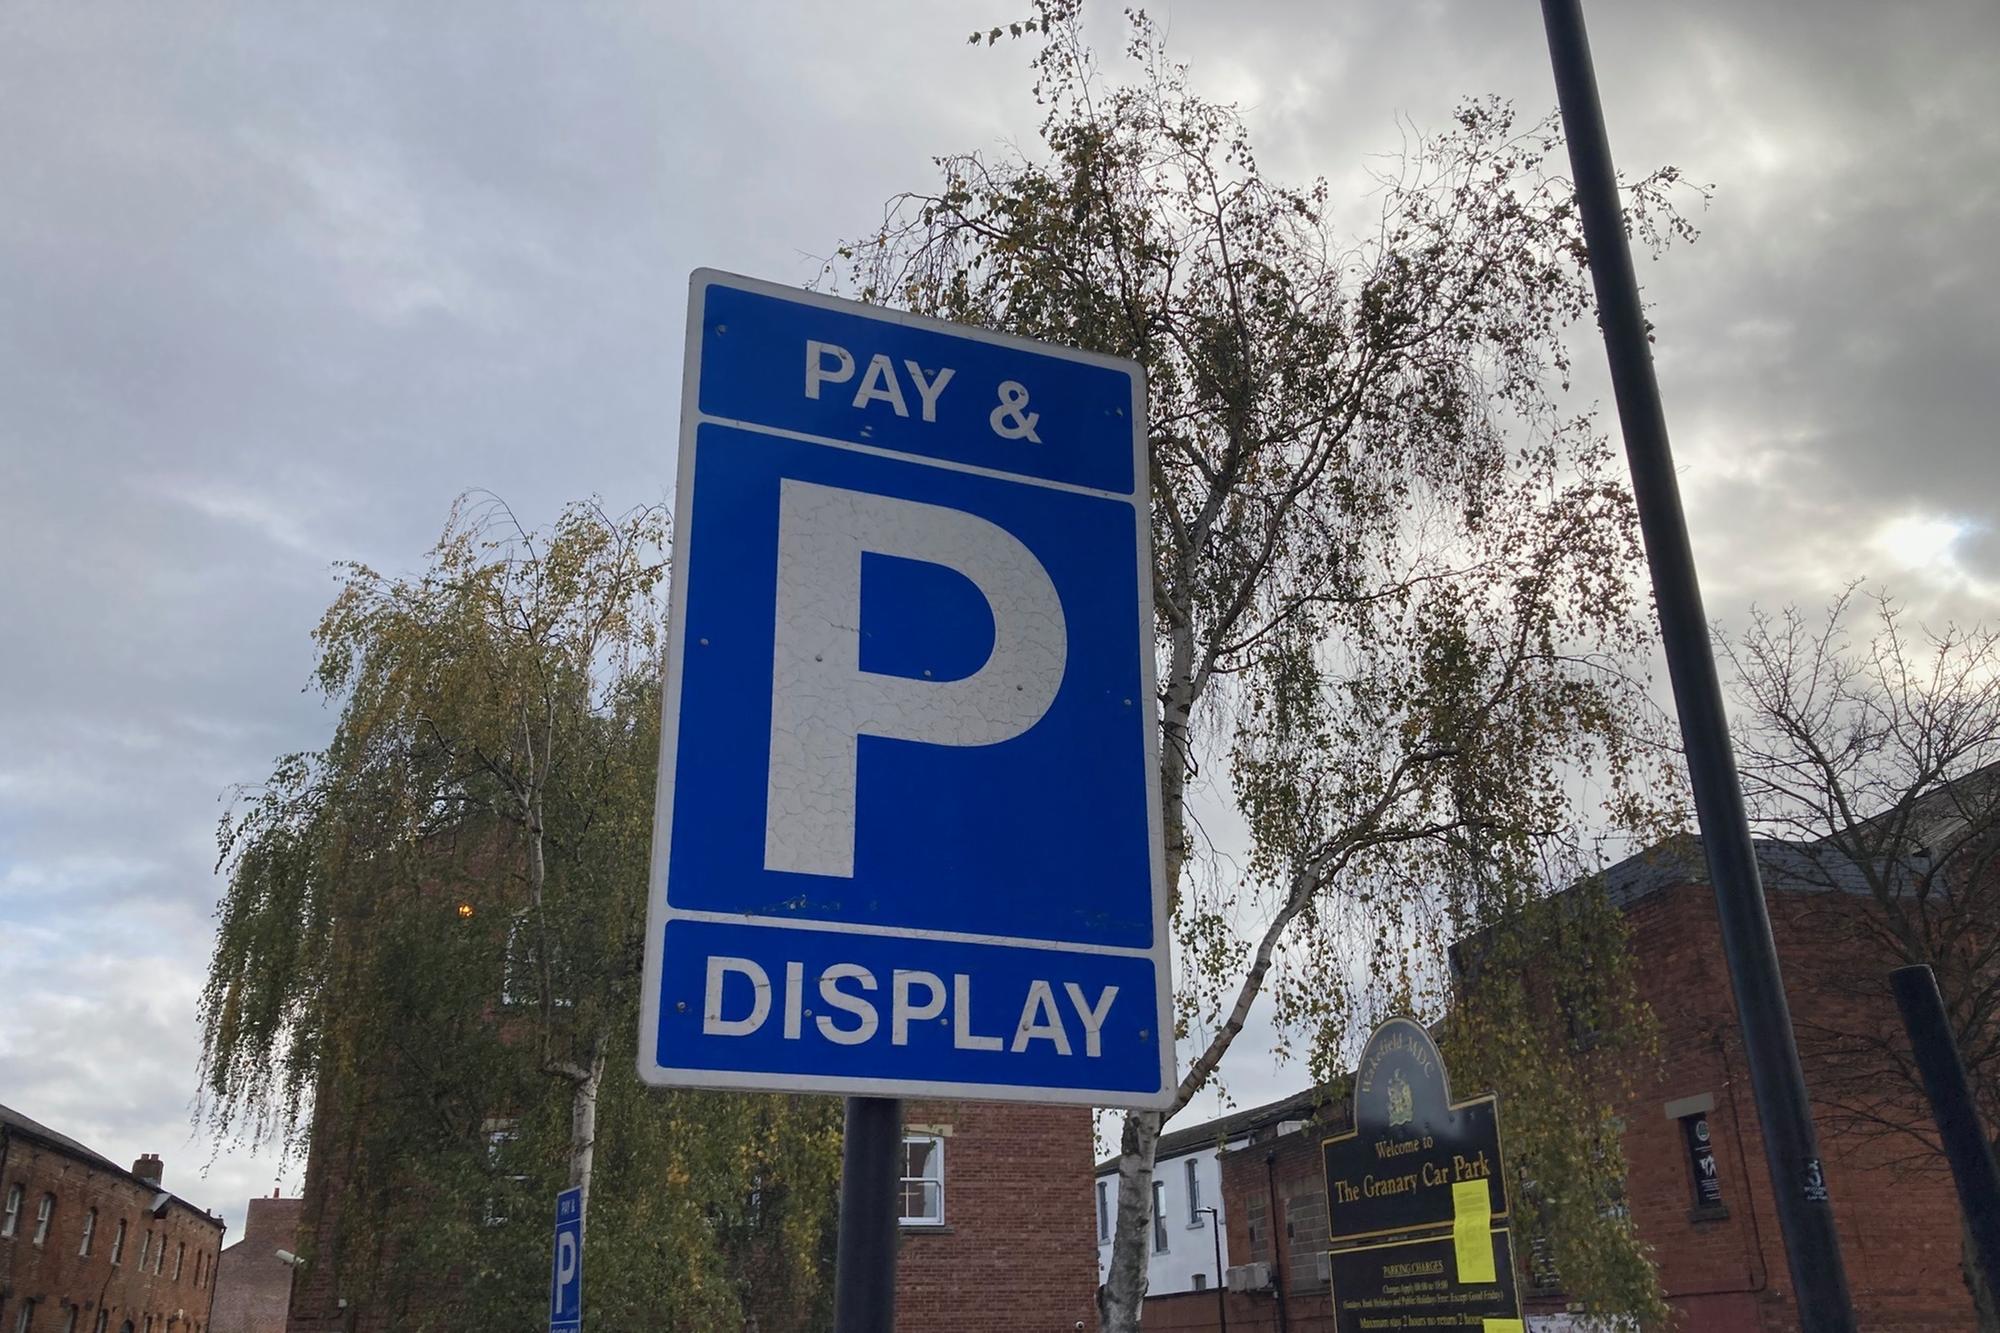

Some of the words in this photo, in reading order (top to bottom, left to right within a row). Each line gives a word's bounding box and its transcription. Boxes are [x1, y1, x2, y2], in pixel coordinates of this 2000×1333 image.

[805, 339, 956, 423] PAY
[989, 379, 1043, 444] &
[764, 477, 1068, 879] P
[702, 955, 1120, 1058] DISPLAY
[1335, 1180, 1360, 1204] The
[1363, 1173, 1418, 1199] Granary
[1422, 1162, 1449, 1187] Car
[1453, 1150, 1491, 1182] Park
[1375, 1141, 1420, 1160] Welcome
[1423, 1135, 1434, 1149] to
[555, 1231, 577, 1314] P
[1383, 1264, 1411, 1277] PARKING
[1411, 1260, 1444, 1275] CHARGES
